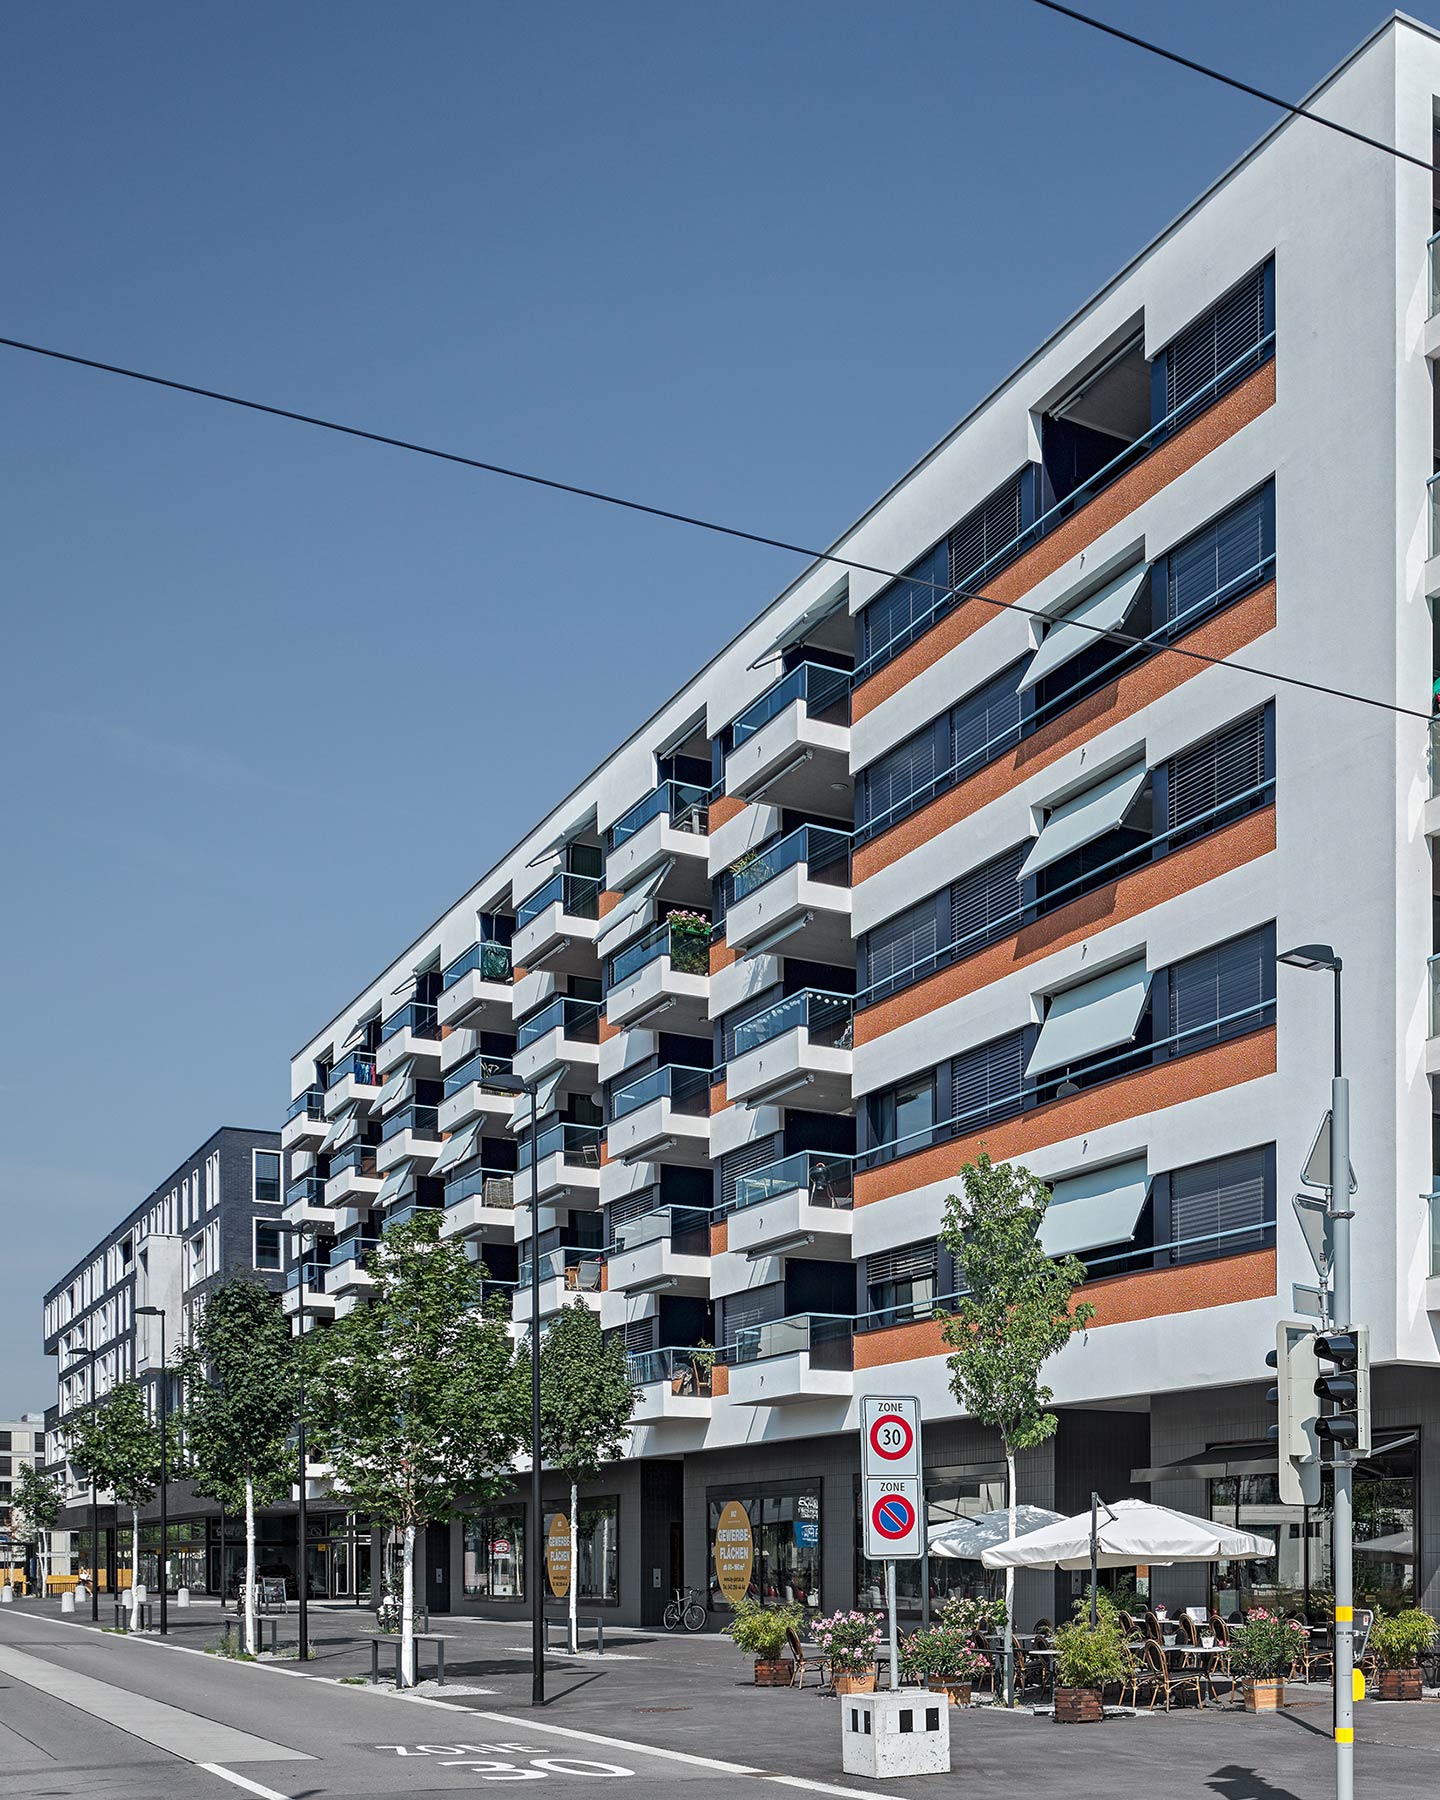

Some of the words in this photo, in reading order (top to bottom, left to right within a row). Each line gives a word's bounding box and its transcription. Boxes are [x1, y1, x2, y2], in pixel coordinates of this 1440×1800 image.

[878, 1402, 903, 1412] ZONE
[883, 1429, 901, 1446] 30
[880, 1482, 905, 1492] ZONE
[717, 1528, 751, 1542] GEWERBE-
[719, 1544, 749, 1560] FLÄCHEN
[374, 1742, 550, 1757] ZONE
[437, 1758, 636, 1780] 30
